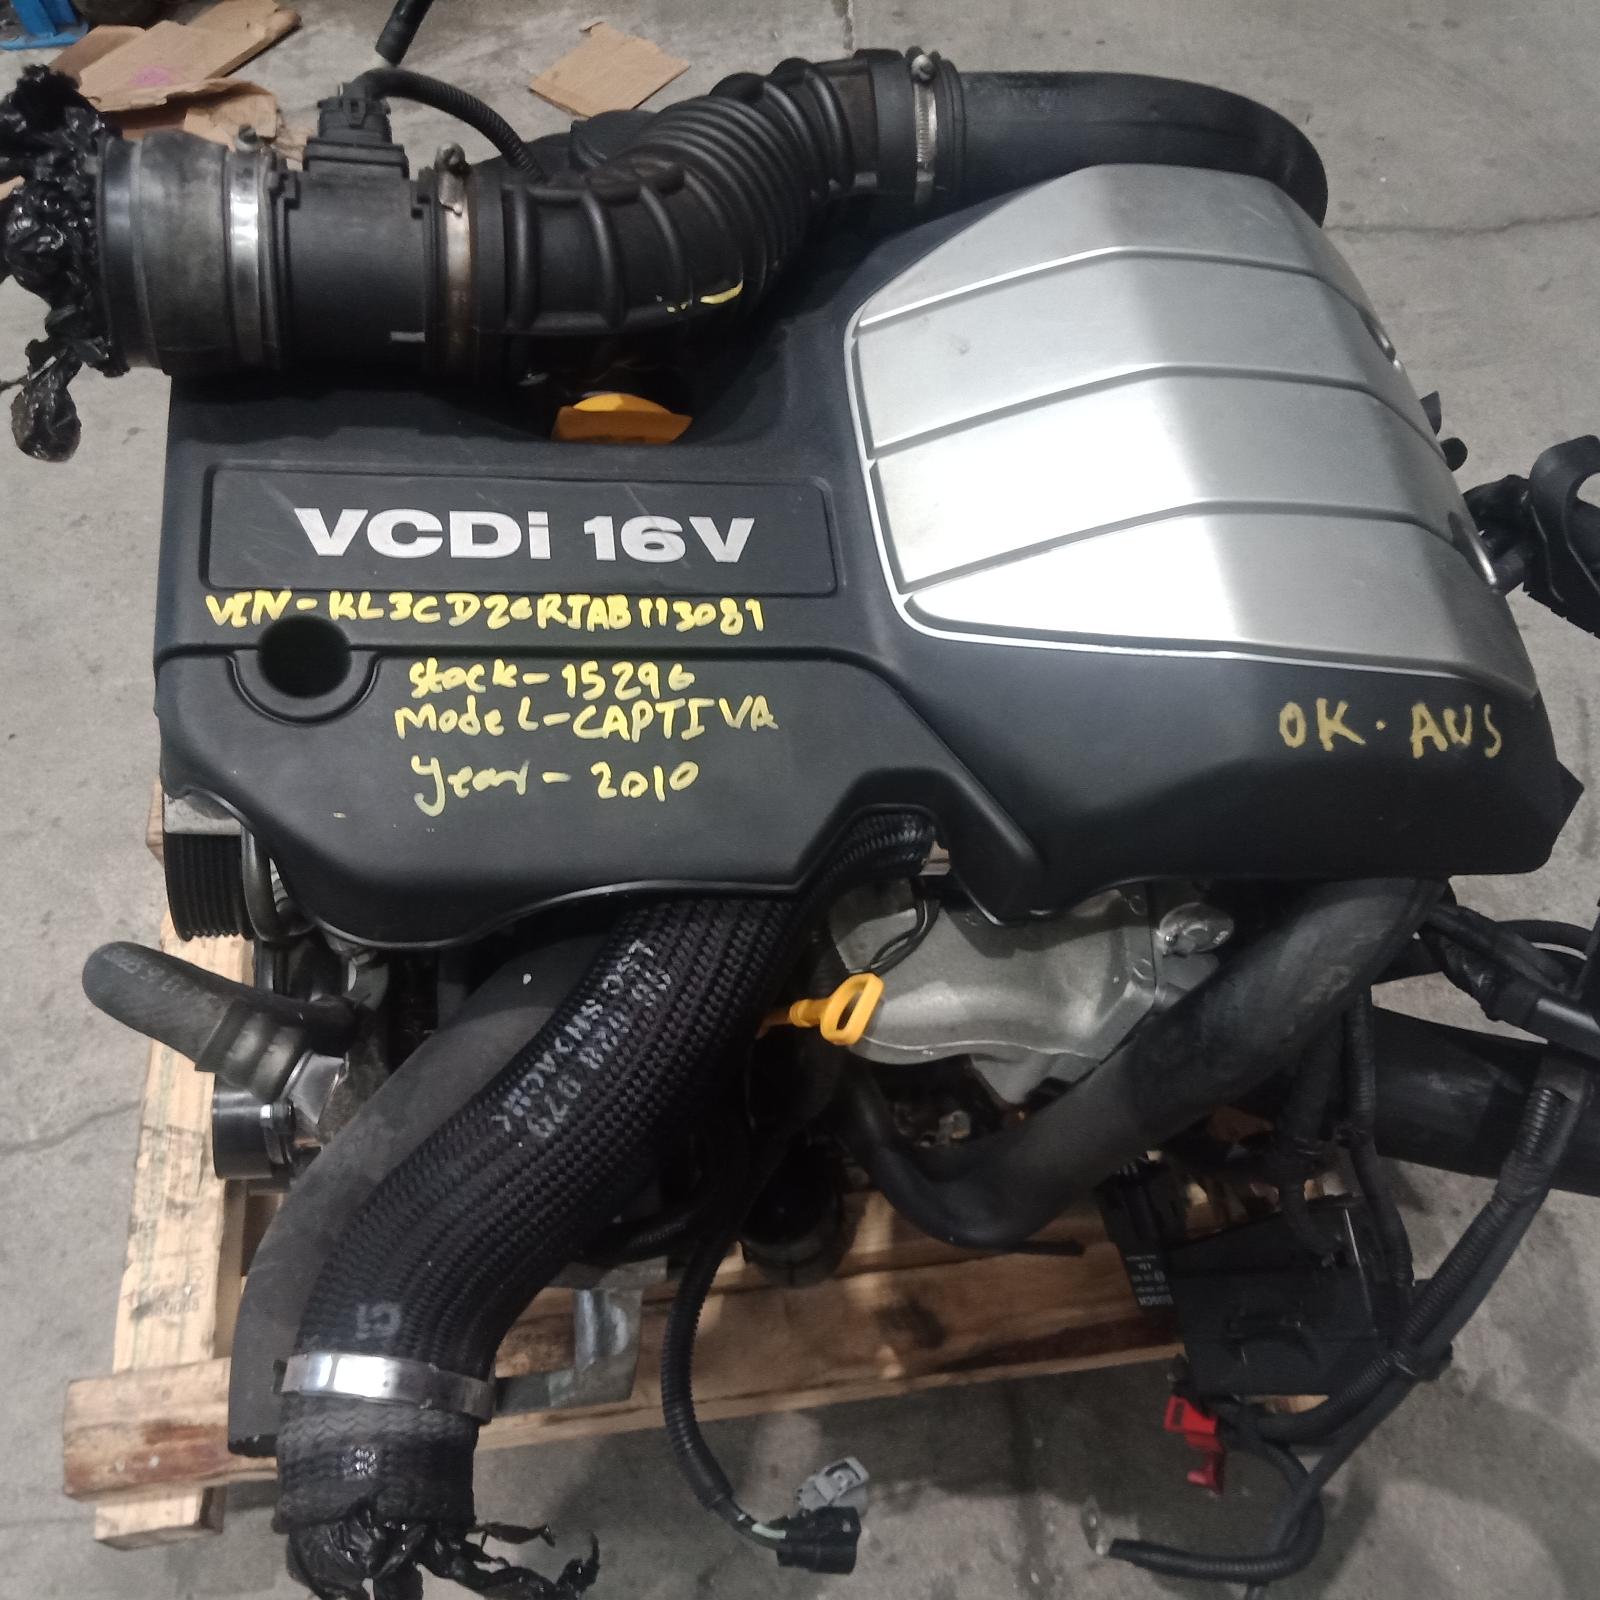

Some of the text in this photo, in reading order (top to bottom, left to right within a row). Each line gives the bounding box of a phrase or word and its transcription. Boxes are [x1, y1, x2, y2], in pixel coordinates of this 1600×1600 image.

[293, 507, 756, 563] VCDi 16V
[590, 760, 700, 802] 2010
